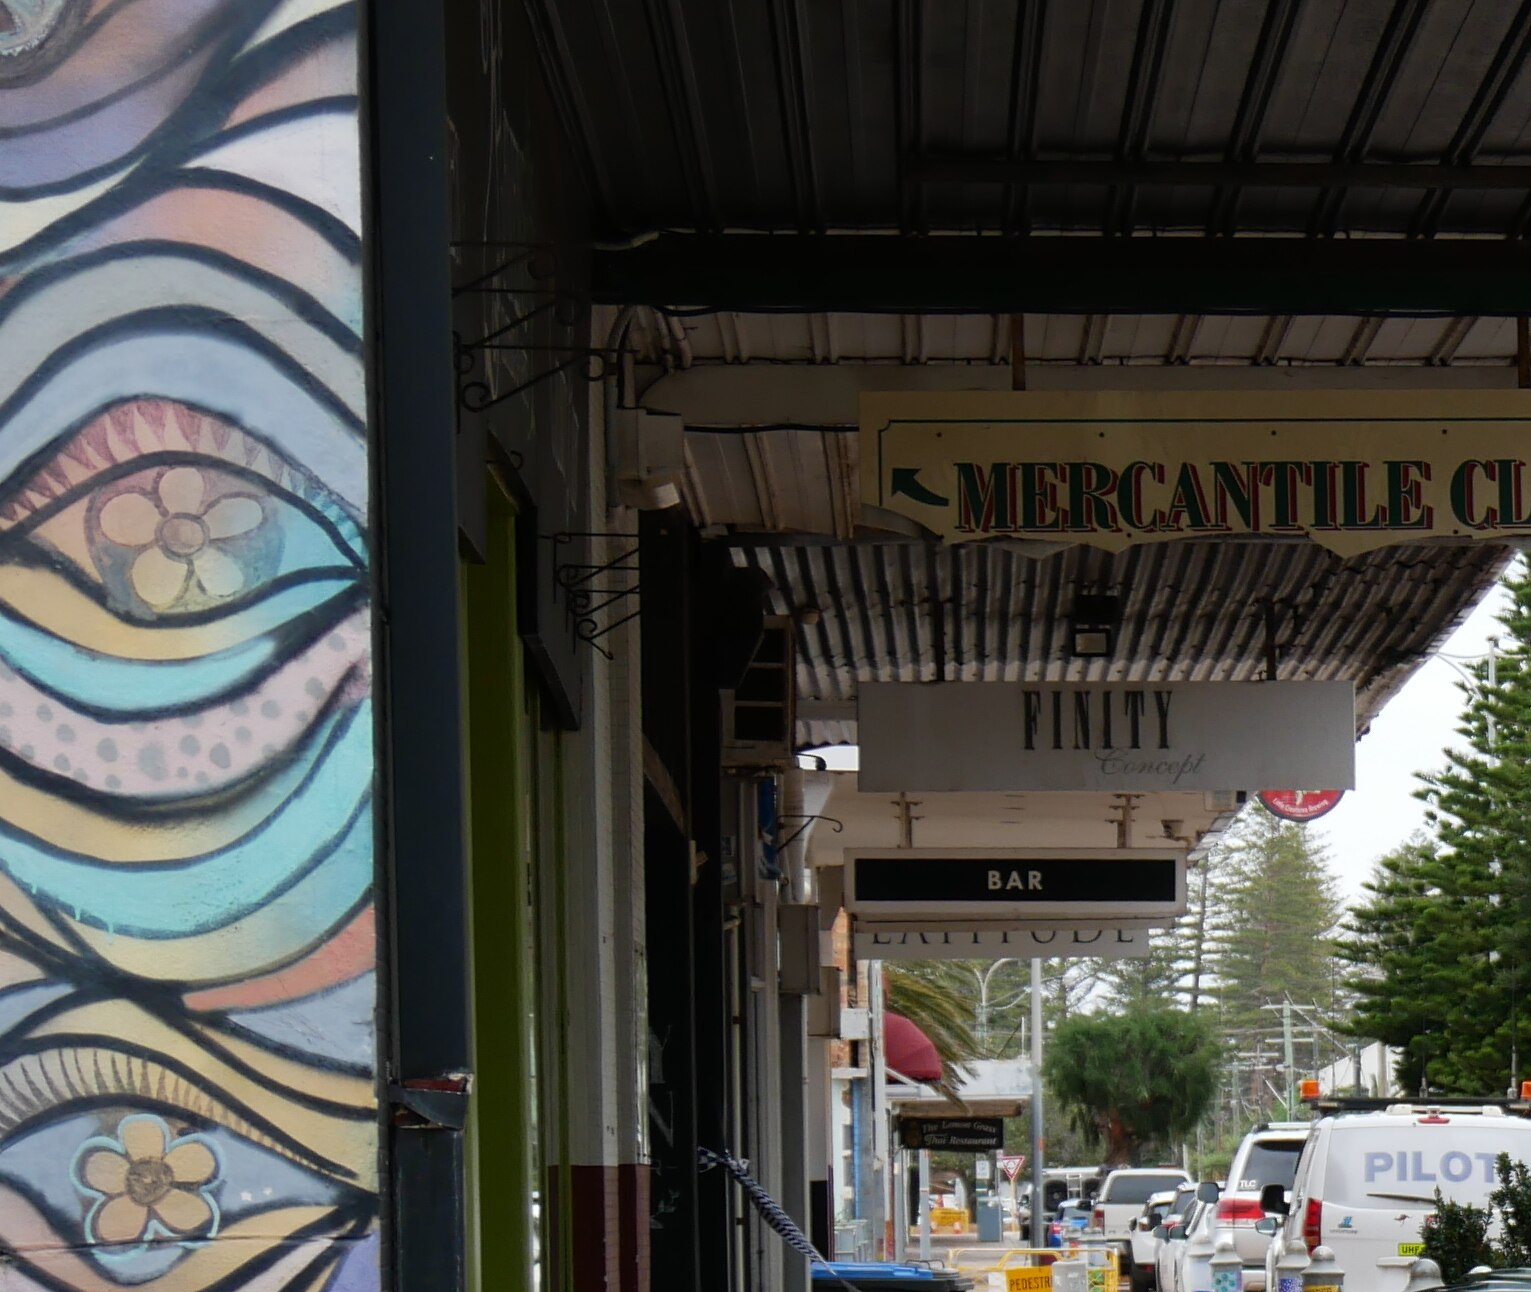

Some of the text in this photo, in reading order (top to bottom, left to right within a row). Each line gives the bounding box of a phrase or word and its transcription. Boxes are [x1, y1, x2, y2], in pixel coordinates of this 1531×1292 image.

[955, 461, 1435, 532] MERCANTILE
[1022, 690, 1173, 751] FINITY
[1096, 747, 1206, 784] Concept
[987, 870, 1043, 891] BAR
[1364, 1150, 1500, 1183] PILOT
[1239, 1179, 1257, 1189] TLC
[1401, 1245, 1420, 1255] UHF
